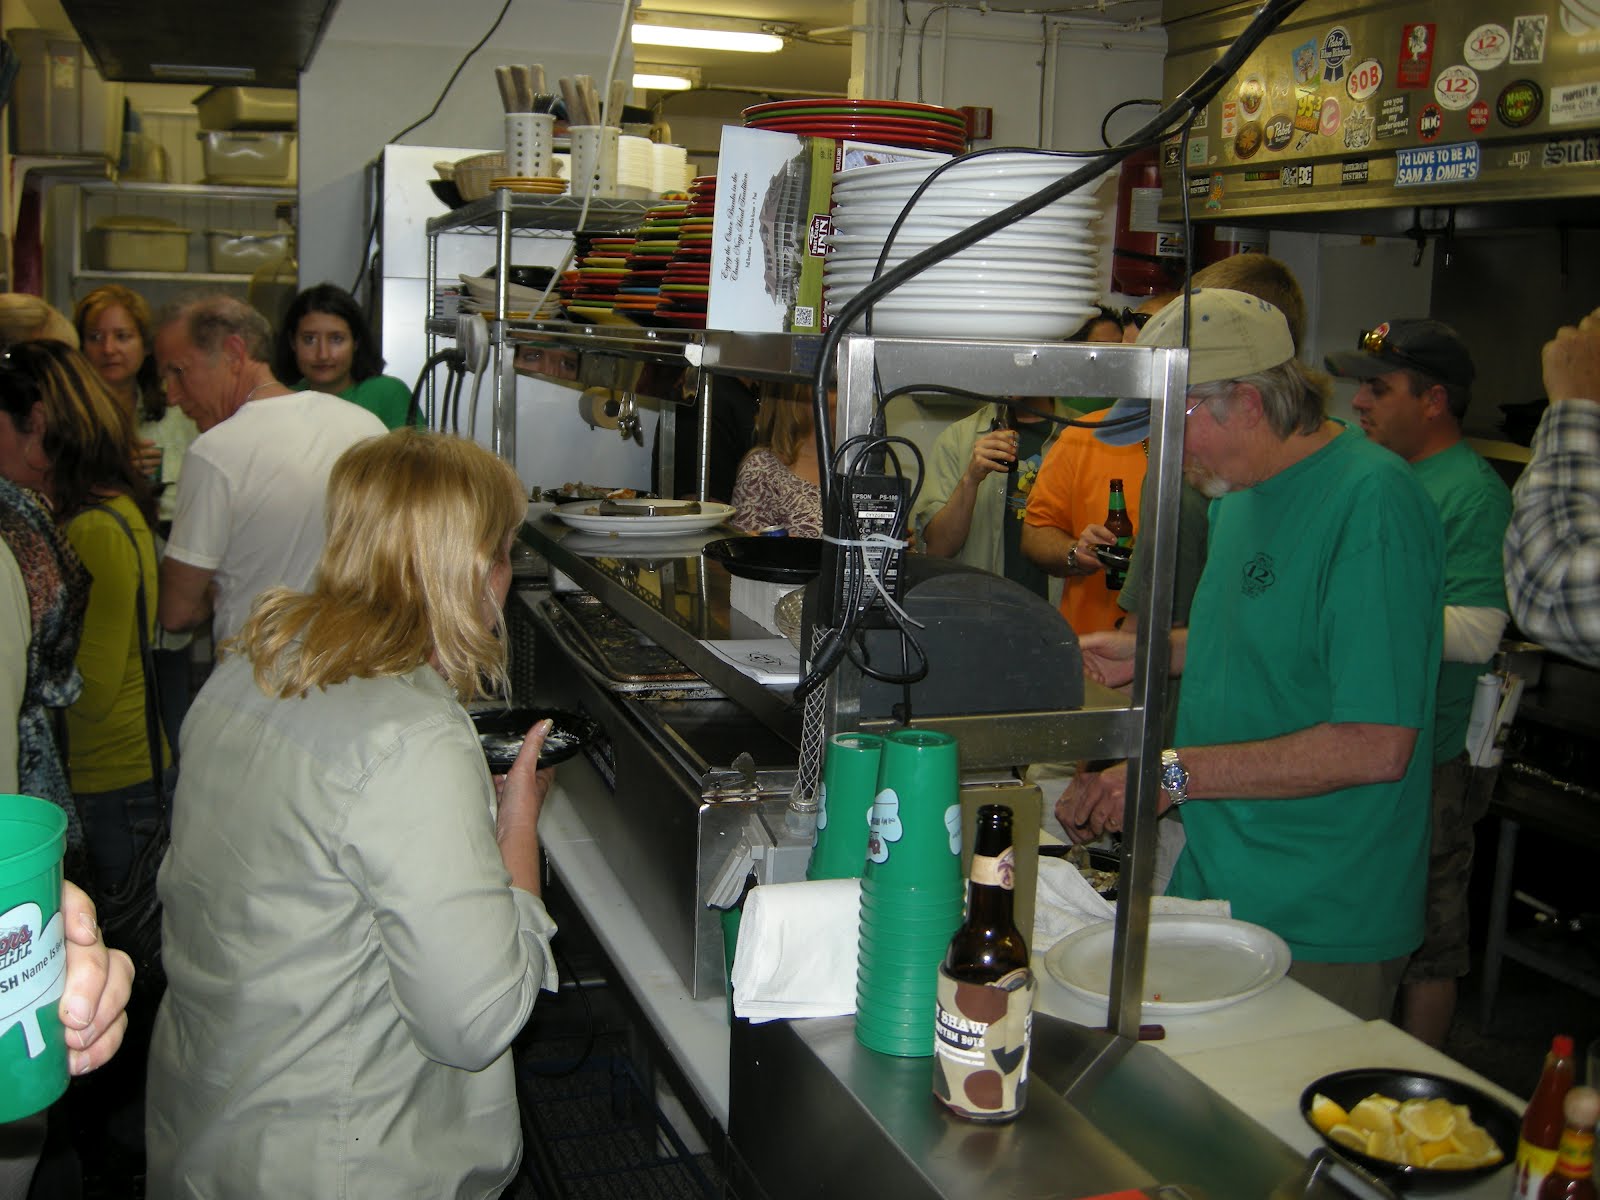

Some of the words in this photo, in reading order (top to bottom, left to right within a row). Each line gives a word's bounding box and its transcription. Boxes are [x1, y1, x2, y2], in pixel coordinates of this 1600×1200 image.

[1328, 34, 1344, 48] Pabst
[1477, 36, 1497, 50] 12
[1351, 65, 1379, 94] SOB
[1445, 79, 1469, 93] 12
[1381, 105, 1404, 115] wearing
[1383, 99, 1392, 107] are
[1393, 97, 1404, 106] you
[1377, 118, 1409, 132] underwear?
[1388, 114, 1397, 122] my
[1274, 121, 1292, 138] Pabst
[1400, 153, 1411, 166] I'd
[1412, 151, 1435, 165] LOVE
[1437, 149, 1449, 163] TO
[1451, 148, 1463, 161] BE
[1464, 146, 1477, 160] AT
[730, 172, 738, 184] the
[1398, 167, 1423, 184] SAM
[1424, 166, 1434, 182] &
[1436, 162, 1477, 181] OMIE'S
[731, 184, 737, 193] in
[738, 173, 748, 208] Tradition
[725, 193, 737, 220] Banks
[735, 208, 745, 232] Head
[724, 221, 734, 243] Outer
[817, 219, 829, 255] INN
[723, 245, 731, 256] the
[733, 233, 745, 256] Nags
[721, 256, 732, 280] Enjoy
[730, 258, 740, 282] Classic
[22, 956, 49, 982] Name
[49, 948, 56, 959] Is
[940, 1010, 989, 1035] SHAW
[961, 1035, 985, 1048] BOYS
